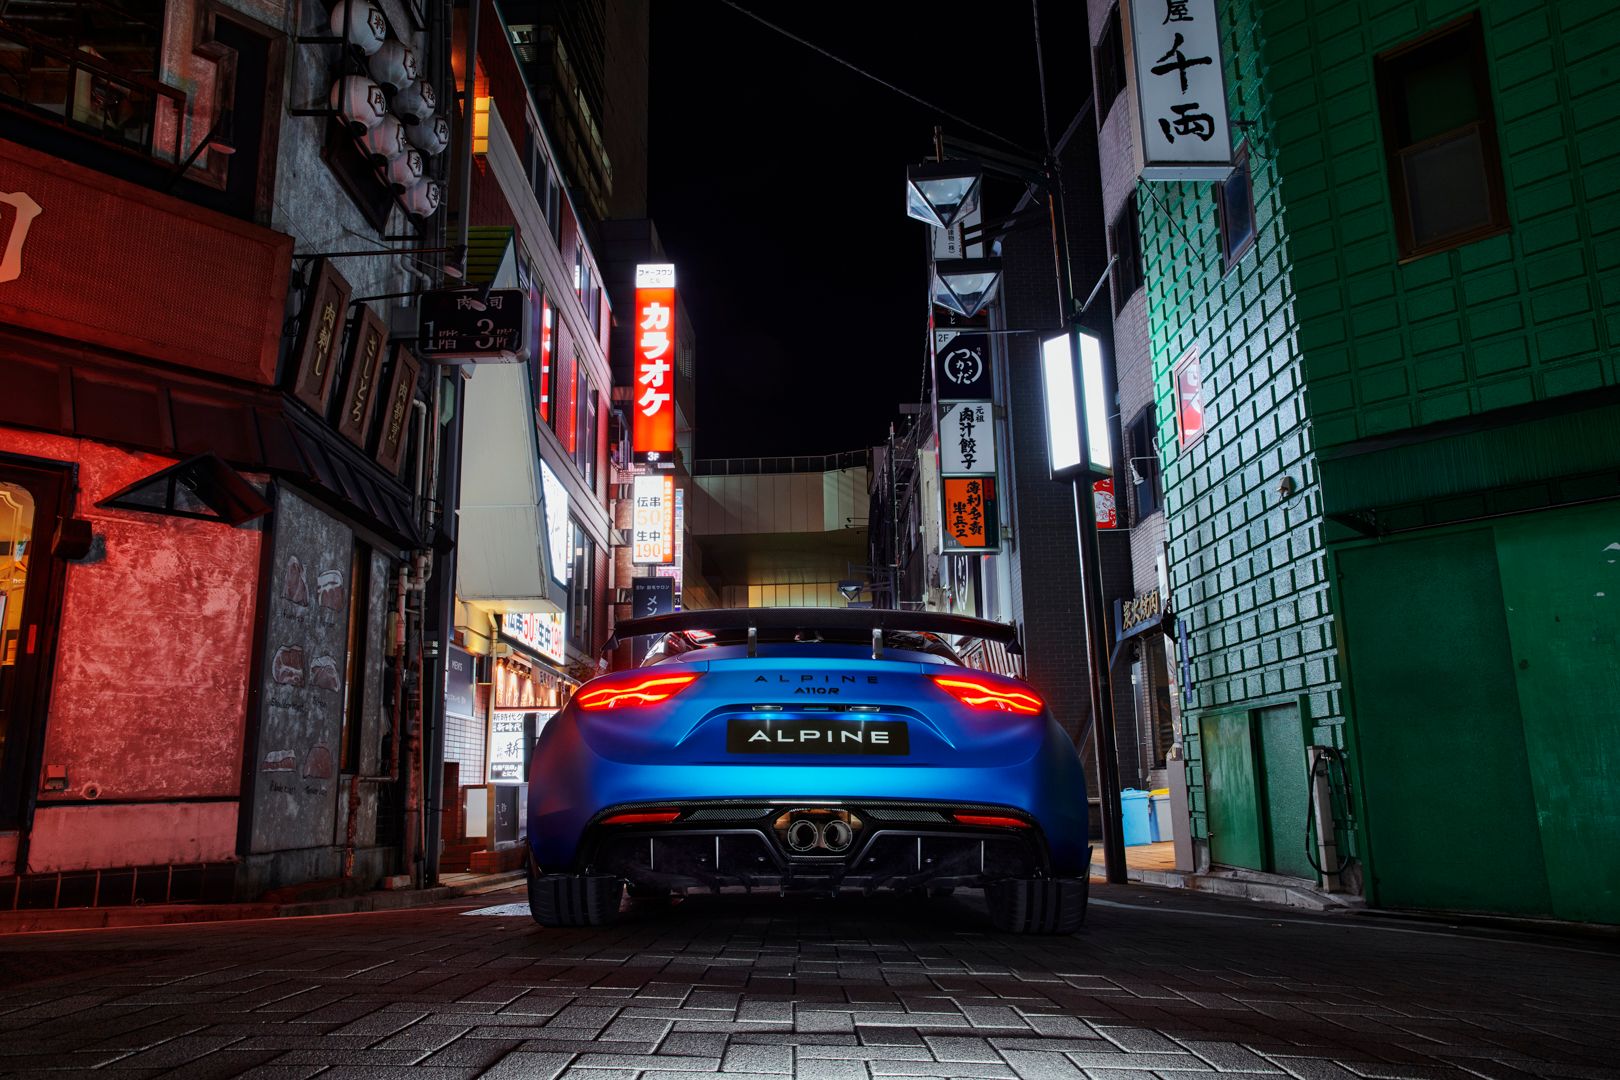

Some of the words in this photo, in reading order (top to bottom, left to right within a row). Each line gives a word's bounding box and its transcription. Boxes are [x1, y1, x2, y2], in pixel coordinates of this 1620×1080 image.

[456, 295, 504, 310] 肉司
[938, 334, 949, 343] 2F
[638, 302, 671, 417] カラオケ
[954, 348, 974, 385] つかだ
[975, 405, 984, 423] 元祖
[959, 407, 977, 470] 肉汁餃子
[647, 452, 660, 461] 3F
[637, 496, 661, 508] 伝串
[637, 511, 661, 526] 50
[636, 530, 661, 542] 生中
[636, 544, 661, 558] 190
[754, 674, 879, 684] ALPINE
[747, 729, 890, 744] ALPINE
